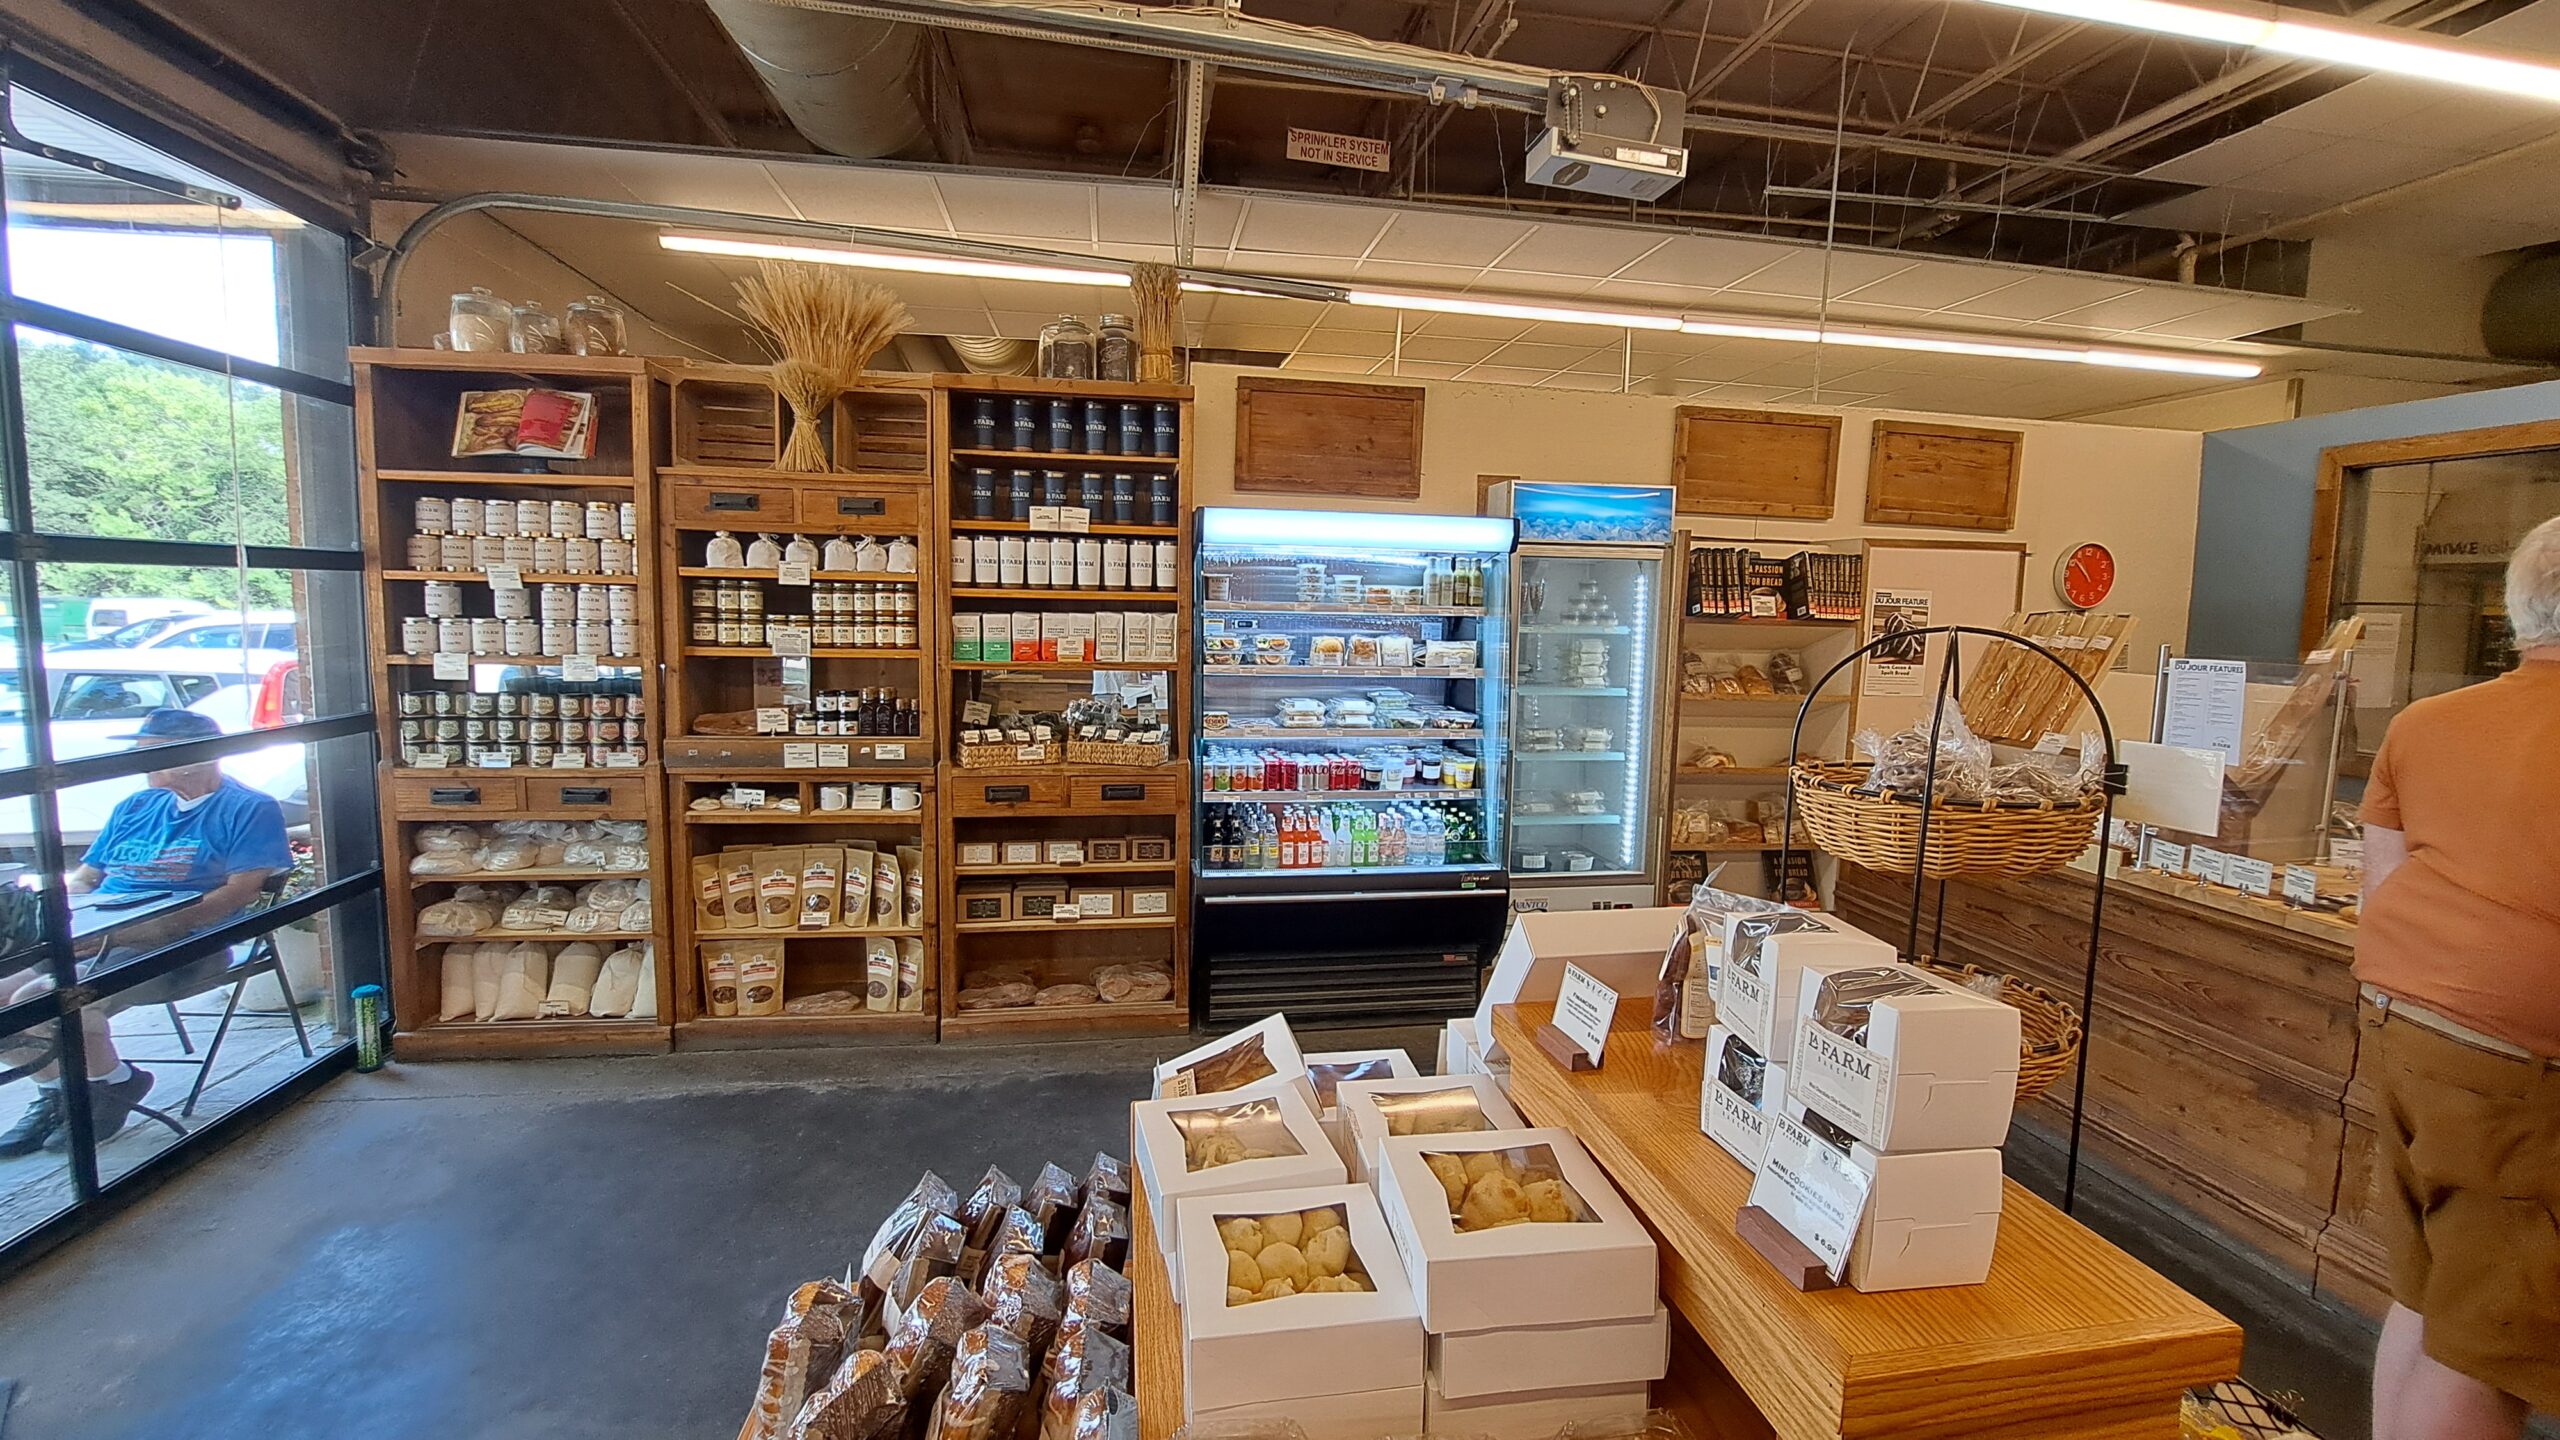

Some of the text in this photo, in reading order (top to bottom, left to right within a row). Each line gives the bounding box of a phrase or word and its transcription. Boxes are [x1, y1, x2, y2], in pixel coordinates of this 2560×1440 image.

[1291, 131, 1389, 155] SPRINKLER SYSTEM
[1300, 146, 1378, 167] NOT IN SERVICE
[2096, 551, 2100, 560] 1
[1755, 565, 1783, 574] PASSION
[2100, 560, 2106, 569] 2
[2102, 572, 2107, 580] 3
[1762, 577, 1783, 586] BREAD
[2071, 590, 2077, 598] 7
[2079, 594, 2085, 602] 6
[2089, 592, 2095, 600] 5
[2187, 664, 2207, 672] JOUR
[2209, 665, 2244, 674] FEATURES
[1731, 972, 1760, 1002] FARM
[1821, 1040, 1872, 1080] FARM
[1725, 1097, 1763, 1136] FARM
[1786, 1119, 1811, 1147] FARM
[1772, 1158, 1789, 1176] MINI
[1789, 1171, 1824, 1203] COOKIES
[1814, 1232, 1837, 1256] $ 6.99
